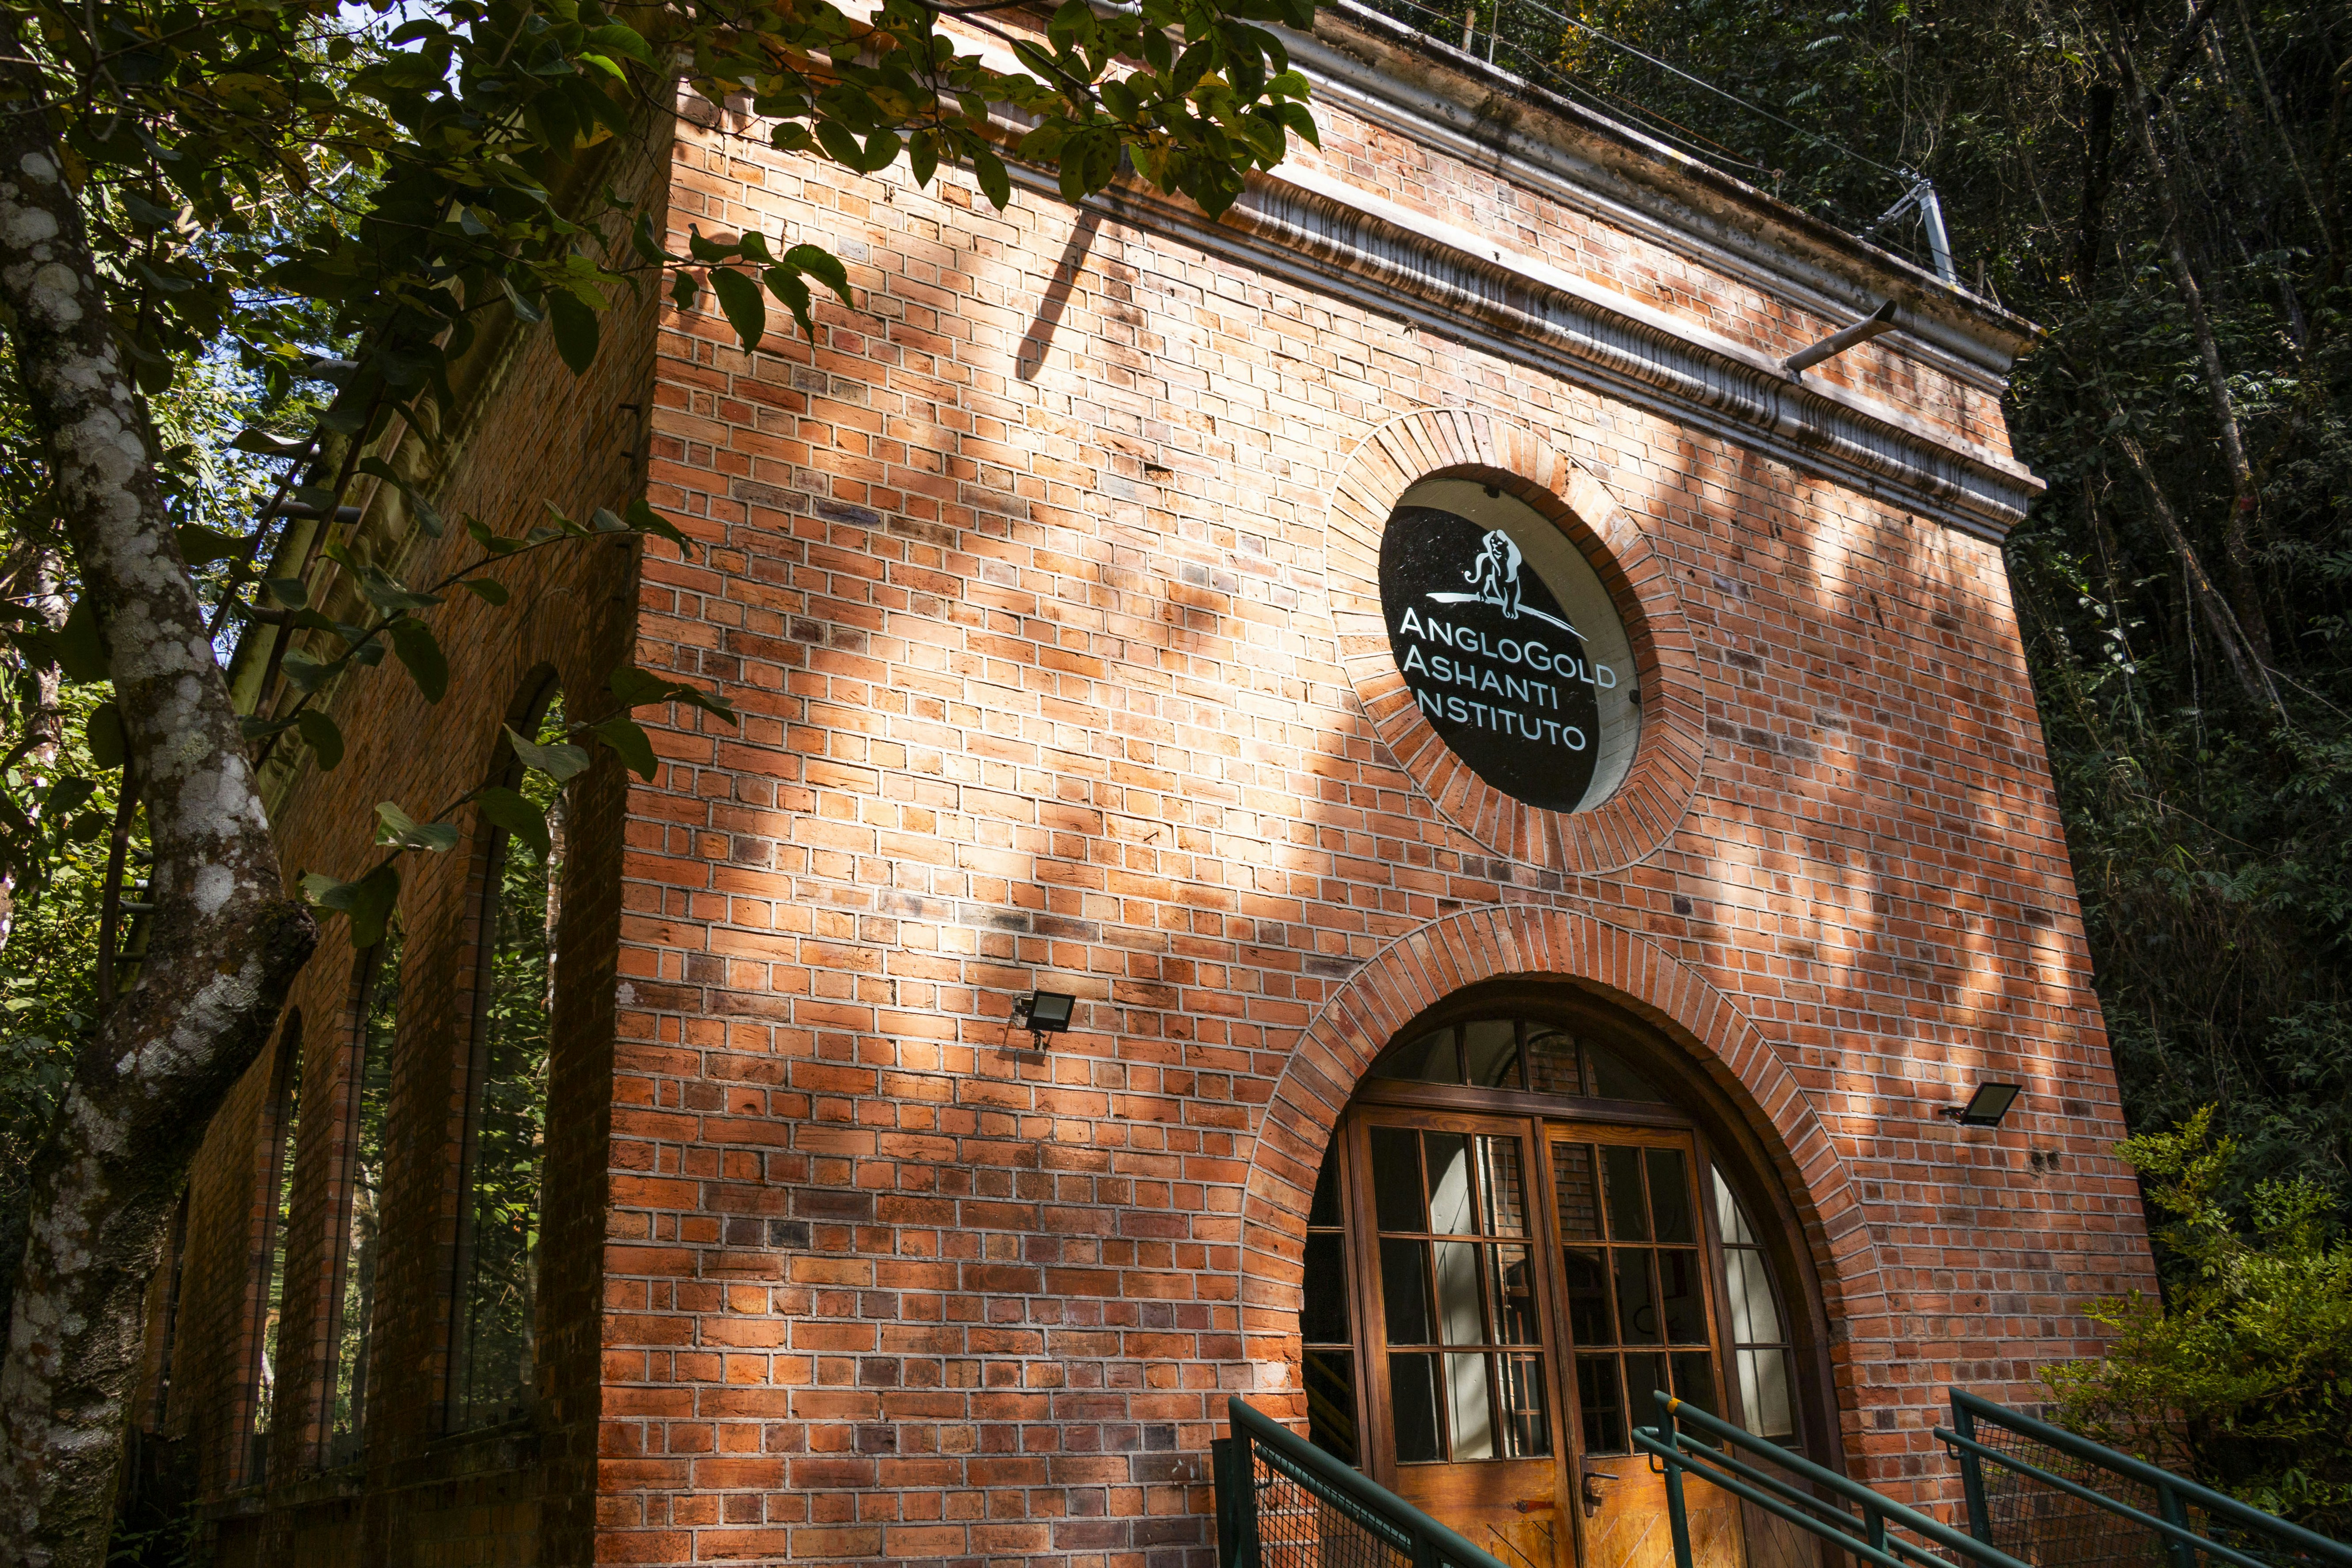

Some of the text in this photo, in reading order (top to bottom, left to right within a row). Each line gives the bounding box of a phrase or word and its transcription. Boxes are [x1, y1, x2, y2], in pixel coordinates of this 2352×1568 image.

[1400, 607, 1616, 688] ANGLOGOLD
[1403, 645, 1558, 710] ASHANTI
[1407, 686, 1586, 751] NSTITUTO
